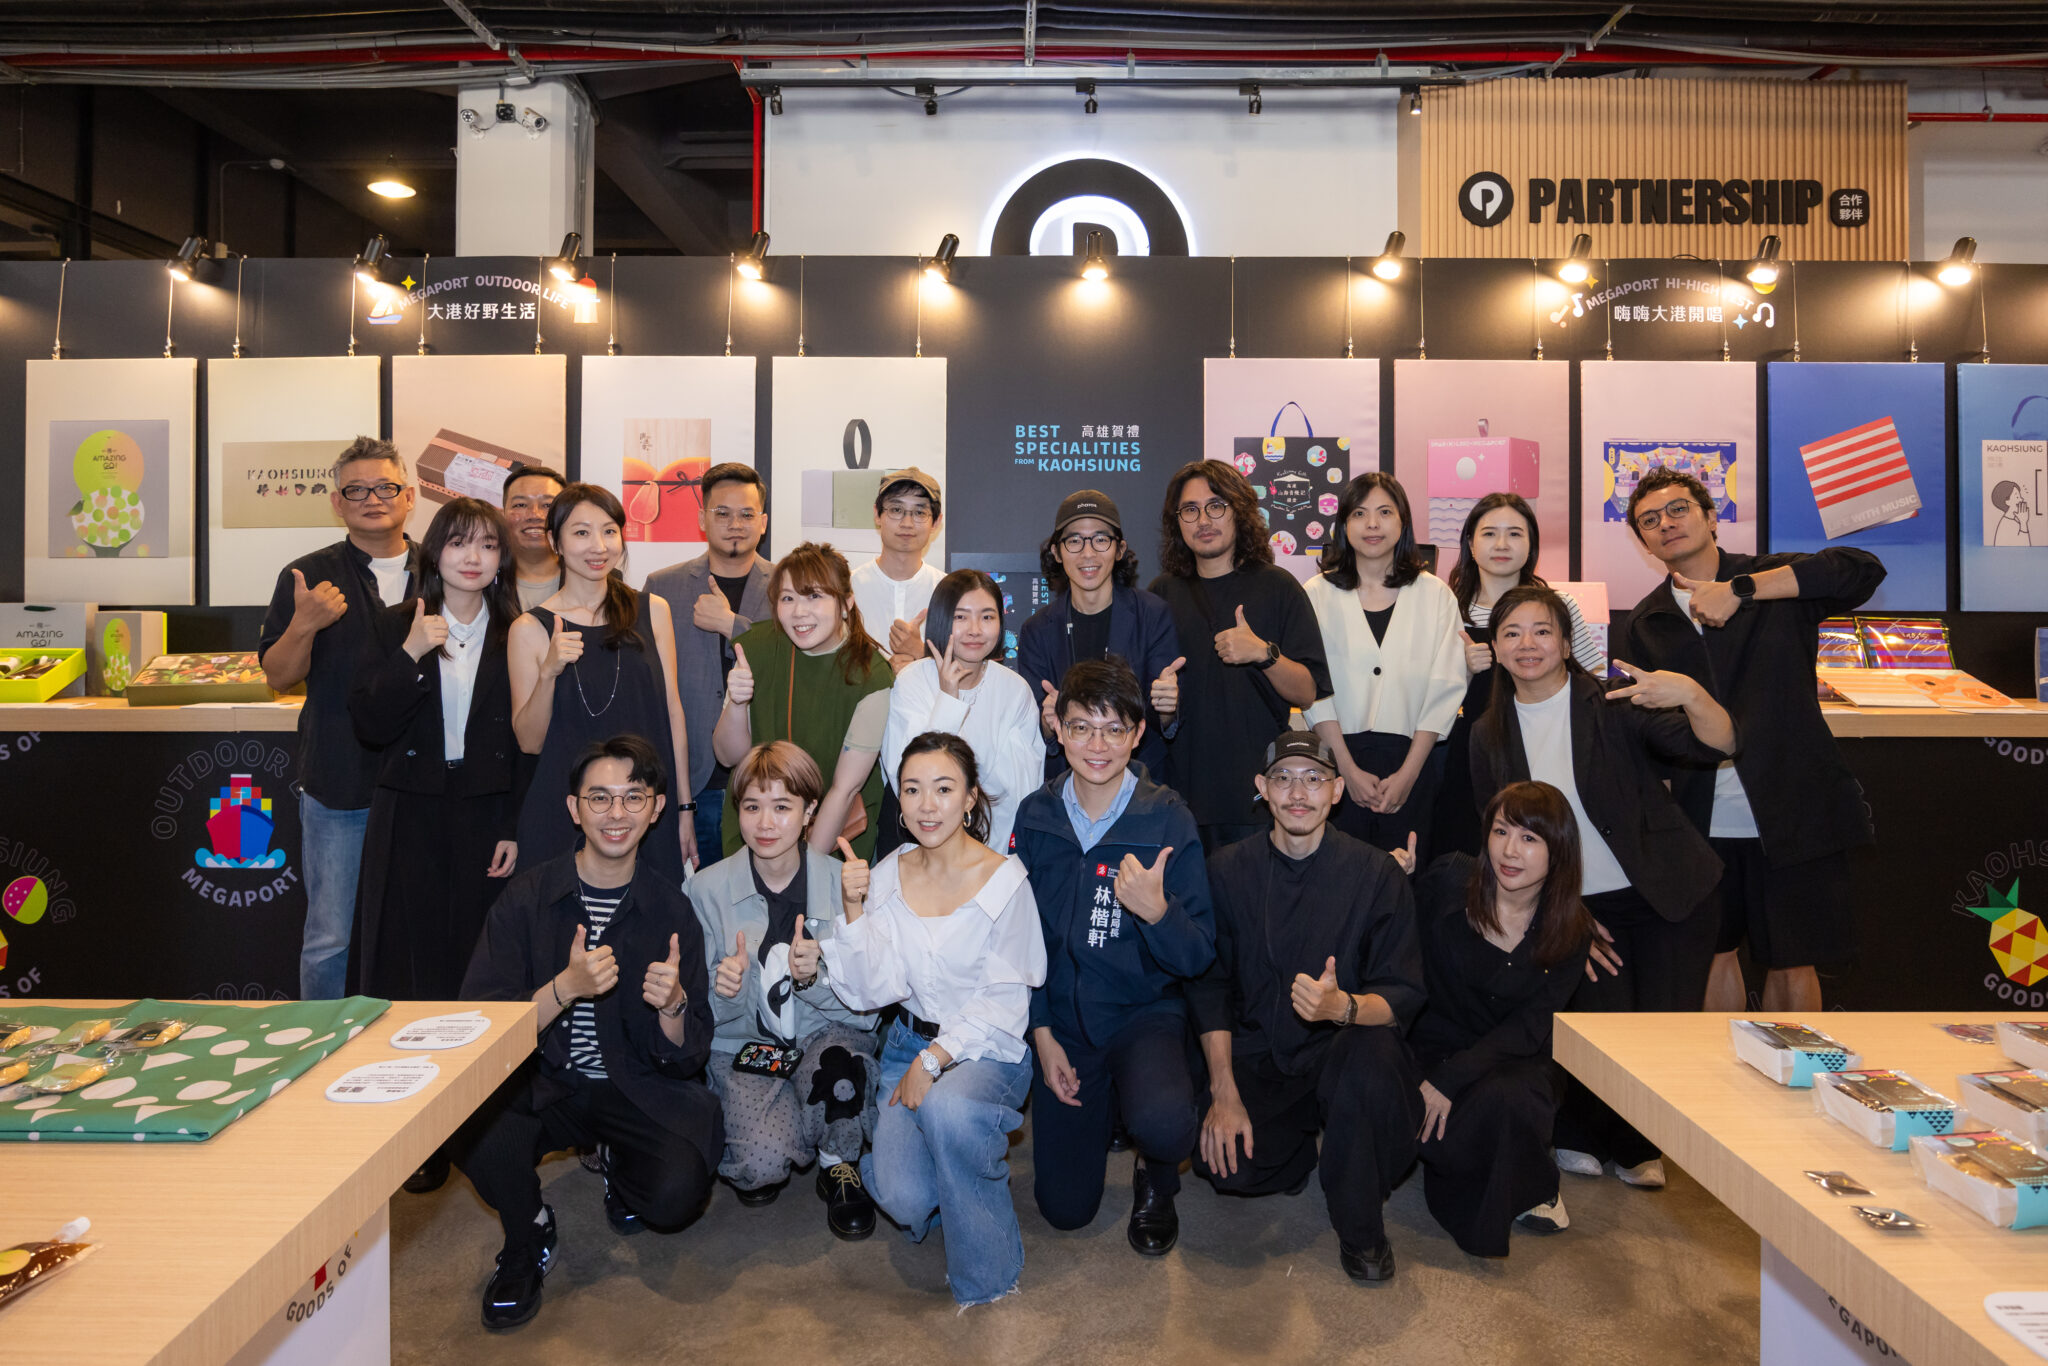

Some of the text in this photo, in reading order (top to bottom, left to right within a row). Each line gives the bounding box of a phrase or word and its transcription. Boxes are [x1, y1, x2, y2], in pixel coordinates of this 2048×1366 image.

[1529, 178, 1824, 225] PARTNERSHIP
[1839, 194, 1863, 207] 合作
[1840, 208, 1863, 220] 夥伴
[399, 275, 570, 311] MEGAPORT OUTDOOR LIFE
[1586, 278, 1660, 311] MEGAPORT
[427, 302, 536, 320] 大港好野生活
[1614, 305, 1723, 323] 嗨嗨大港開唱
[1015, 425, 1060, 438] BEST
[1081, 425, 1140, 438] 高雄賀禮
[1015, 442, 1140, 455] SPECIALITIES
[1986, 445, 2043, 453] KAOHSIUNG
[1038, 459, 1141, 472] KAOHSIUNG
[1850, 507, 1880, 523] WITH
[1881, 494, 1917, 513] MUSIC
[16, 630, 64, 638] AMAZING
[30, 639, 51, 648] GO!
[151, 740, 290, 840] OUTDOOR
[181, 866, 299, 908] MEGAPORT
[1087, 885, 1111, 948] 林楷軒
[16, 967, 43, 994] OF
[286, 1244, 352, 1322] GOODS OF
